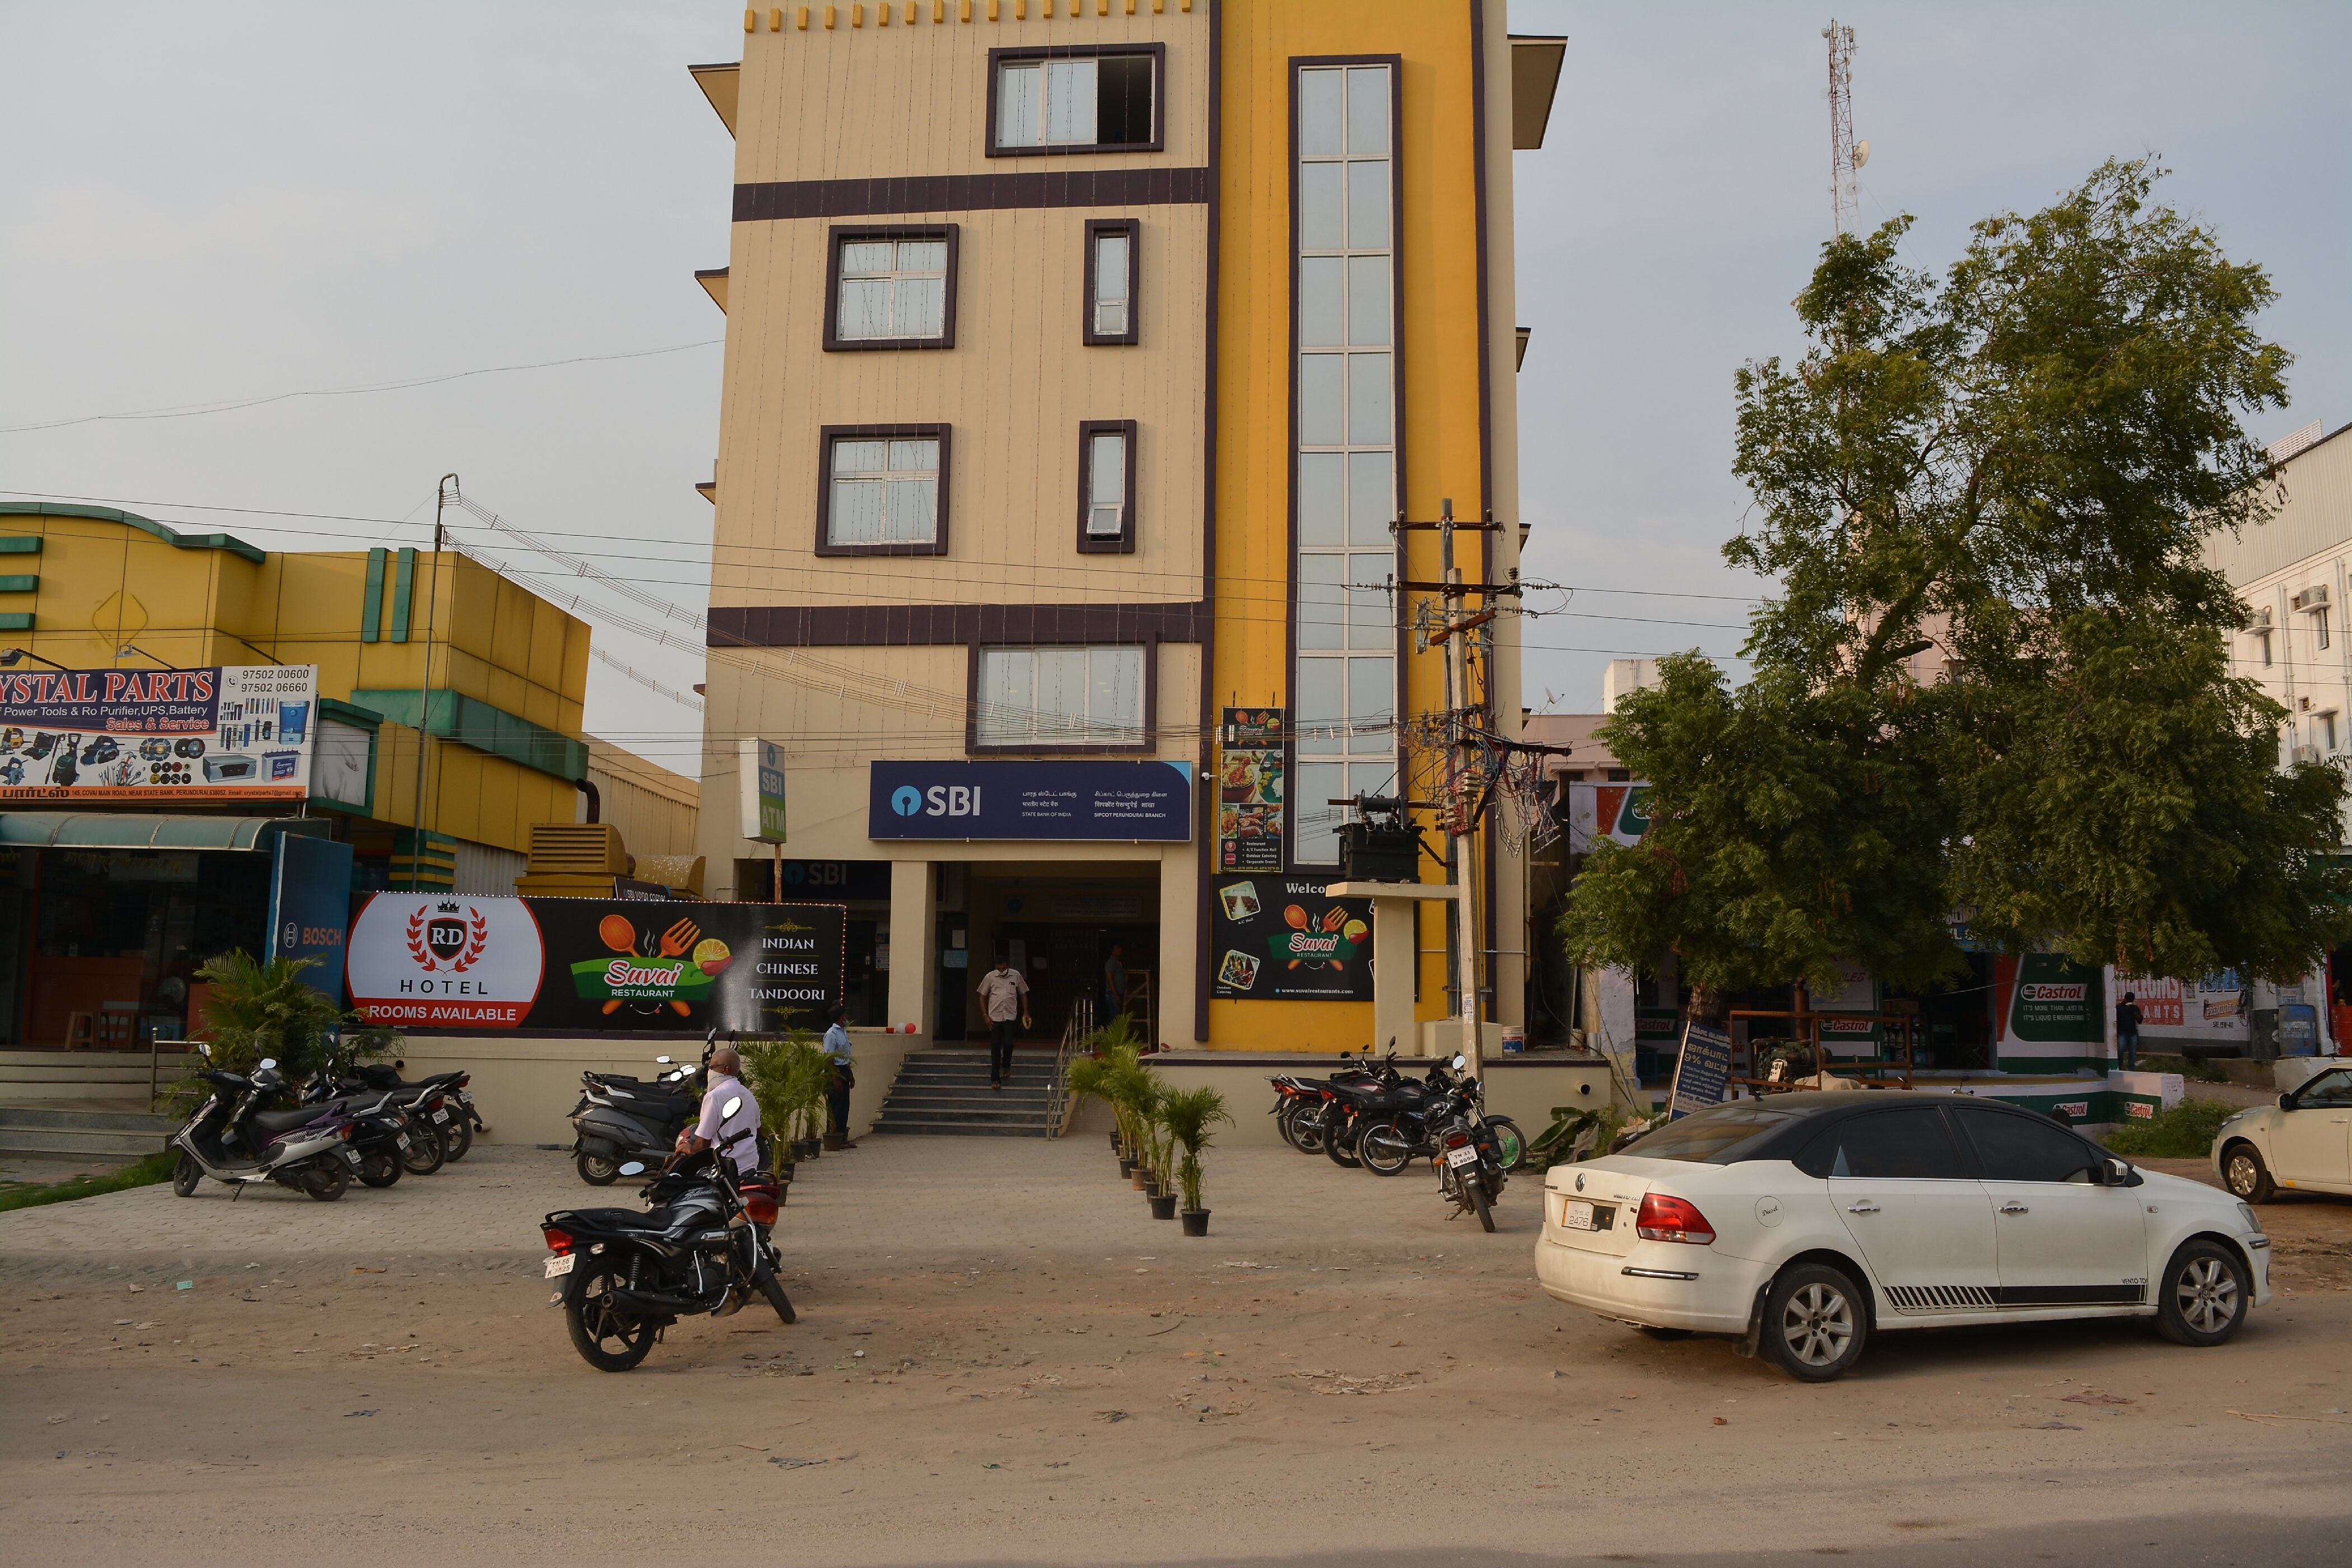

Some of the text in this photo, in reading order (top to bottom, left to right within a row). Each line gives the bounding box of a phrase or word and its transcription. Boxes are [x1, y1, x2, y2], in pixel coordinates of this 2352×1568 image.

[243, 669, 309, 679] 97502 00600
[102, 671, 213, 702] PARTS
[241, 683, 308, 692] 97502 06660
[4, 707, 38, 717] Power
[40, 707, 68, 716] Tools
[71, 707, 78, 716] &
[82, 707, 97, 716] Ro
[106, 716, 209, 731] Sales & Service
[762, 771, 782, 795] SBI
[925, 785, 980, 816] SBI
[762, 805, 785, 832] ATM
[808, 862, 847, 885] SBI
[1286, 883, 1325, 894] Welco
[302, 927, 342, 946] BOSCH
[431, 927, 464, 945] RD
[1289, 932, 1339, 952] Suvai
[762, 937, 814, 950] INDIAN
[603, 959, 685, 987] Suvai
[756, 963, 819, 976] CHINESE
[400, 979, 488, 996] HOTEL
[611, 988, 675, 998] RESTAURANT
[749, 987, 825, 1001] TANDOORI
[2037, 985, 2081, 999] Castrol
[369, 1005, 516, 1022] ROOMS AVAILABLE
[2205, 1002, 2233, 1017] PREMIUM
[1635, 1019, 1671, 1030] Castrol
[1833, 1021, 1869, 1031] Castrol
[1684, 1053, 1701, 1065] 9%
[2130, 1103, 2151, 1117] Castrol
[1762, 1205, 1778, 1216] Diesel
[1569, 1216, 1589, 1226] 2476
